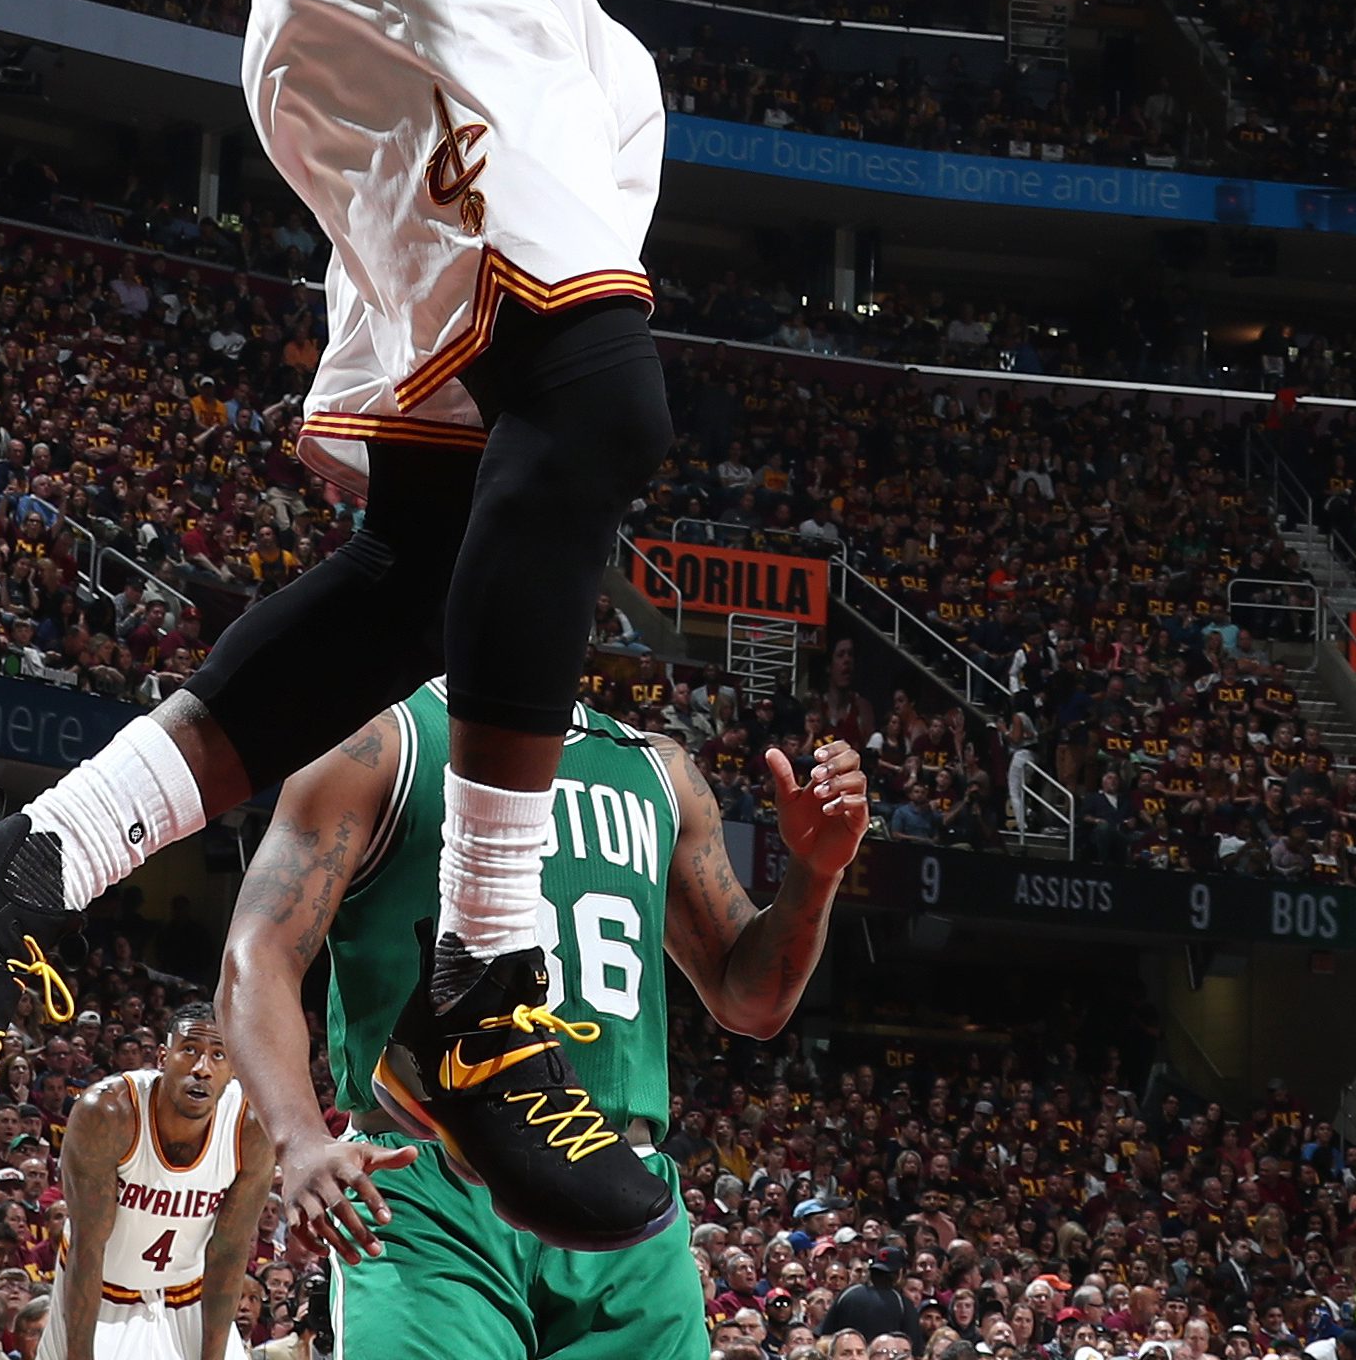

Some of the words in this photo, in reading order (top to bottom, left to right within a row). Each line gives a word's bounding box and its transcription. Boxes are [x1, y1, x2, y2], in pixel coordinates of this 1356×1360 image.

[686, 128, 762, 162] your
[771, 132, 927, 188] business,
[937, 158, 1043, 199] home
[1051, 170, 1121, 205] and
[1130, 170, 1181, 210] life
[646, 546, 810, 615] GORILLA
[920, 855, 940, 905] 9
[1014, 871, 1113, 913] ASSISTS
[1189, 883, 1211, 930] 9
[1271, 889, 1338, 939] BOS
[142, 1229, 177, 1272] 4
